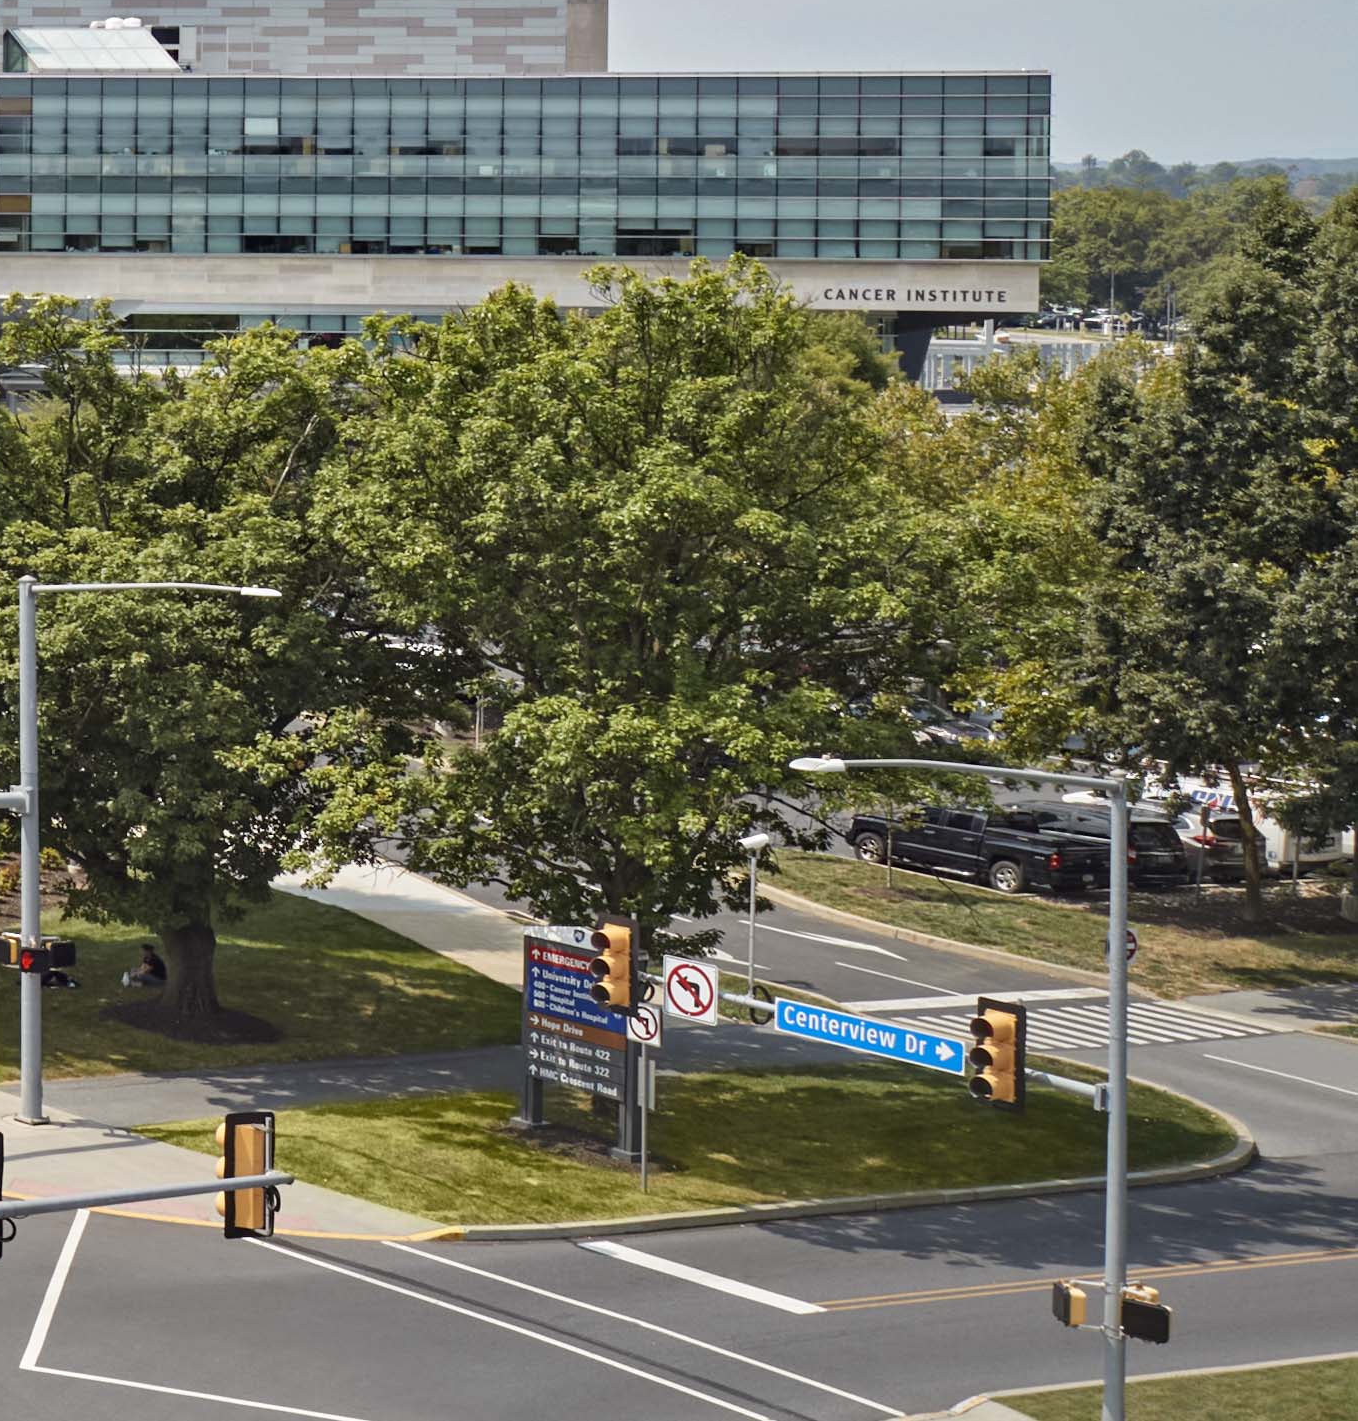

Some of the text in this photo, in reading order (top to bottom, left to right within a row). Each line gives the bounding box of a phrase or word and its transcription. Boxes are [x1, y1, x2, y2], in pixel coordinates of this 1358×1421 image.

[824, 288, 1007, 303] CANCER INSTITUTE
[543, 951, 591, 971] EMERGENCY
[542, 969, 581, 989] University
[541, 1017, 583, 1037] Hope Drive
[784, 1005, 927, 1056] Centerview Dr
[540, 1034, 611, 1061] Exit to Route 422
[540, 1050, 610, 1078] Exit to Route 322
[539, 1067, 618, 1097] HMC Crescent Road
